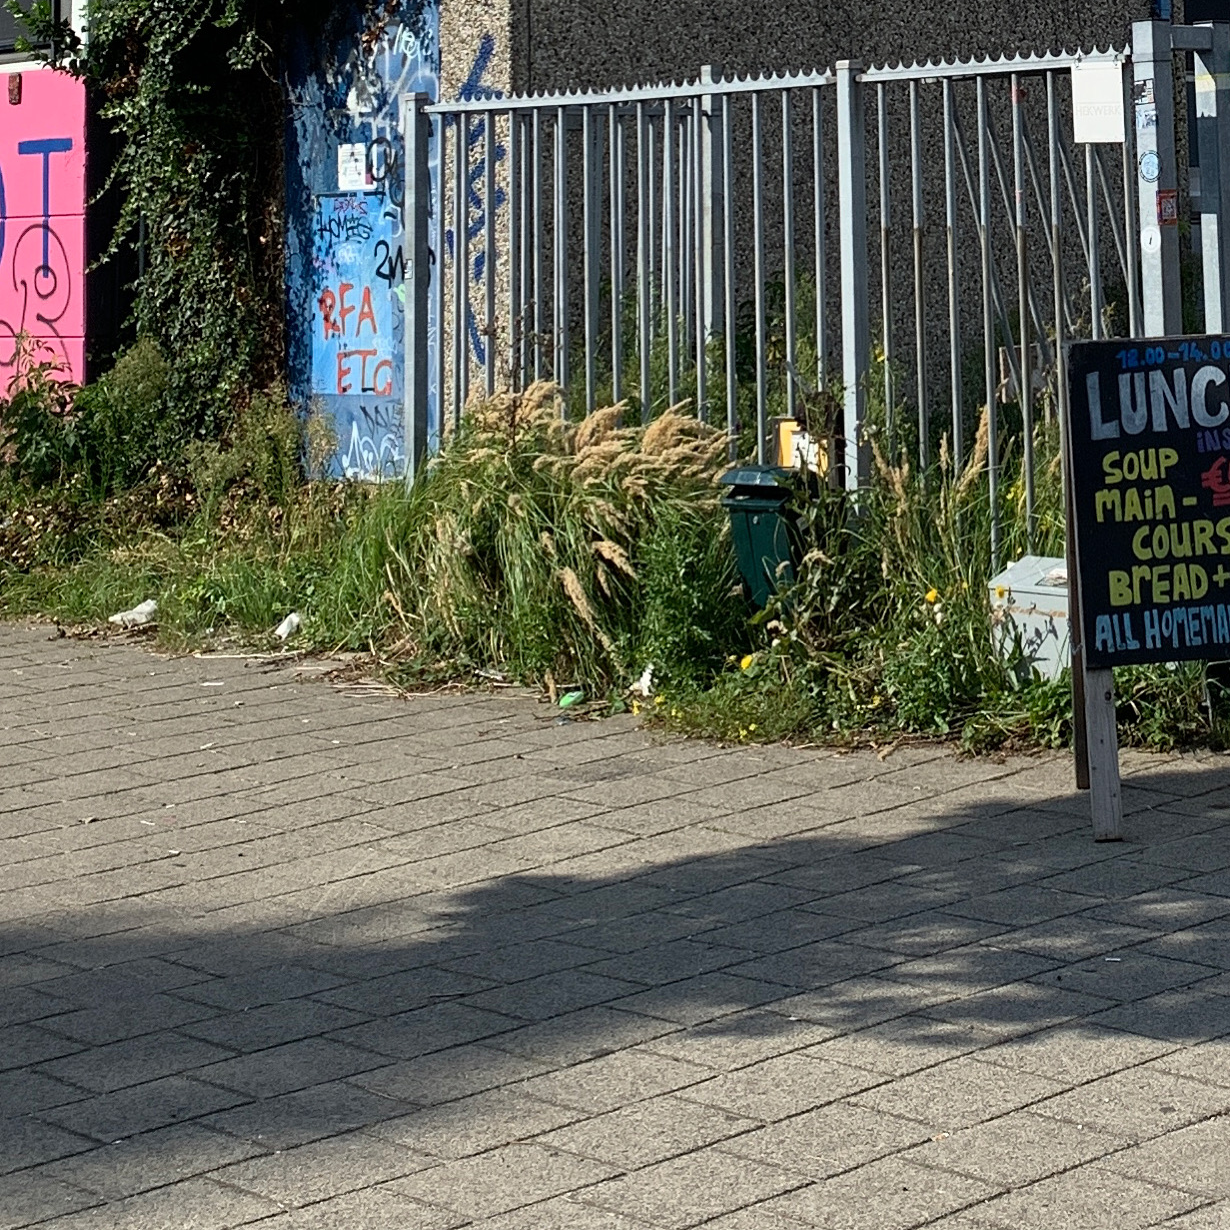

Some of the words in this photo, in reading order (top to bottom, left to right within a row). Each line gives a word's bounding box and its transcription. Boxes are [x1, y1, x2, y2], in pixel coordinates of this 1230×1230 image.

[318, 282, 378, 341] RFA
[1102, 448, 1180, 485] SOUP
[1095, 613, 1141, 654] ALL
